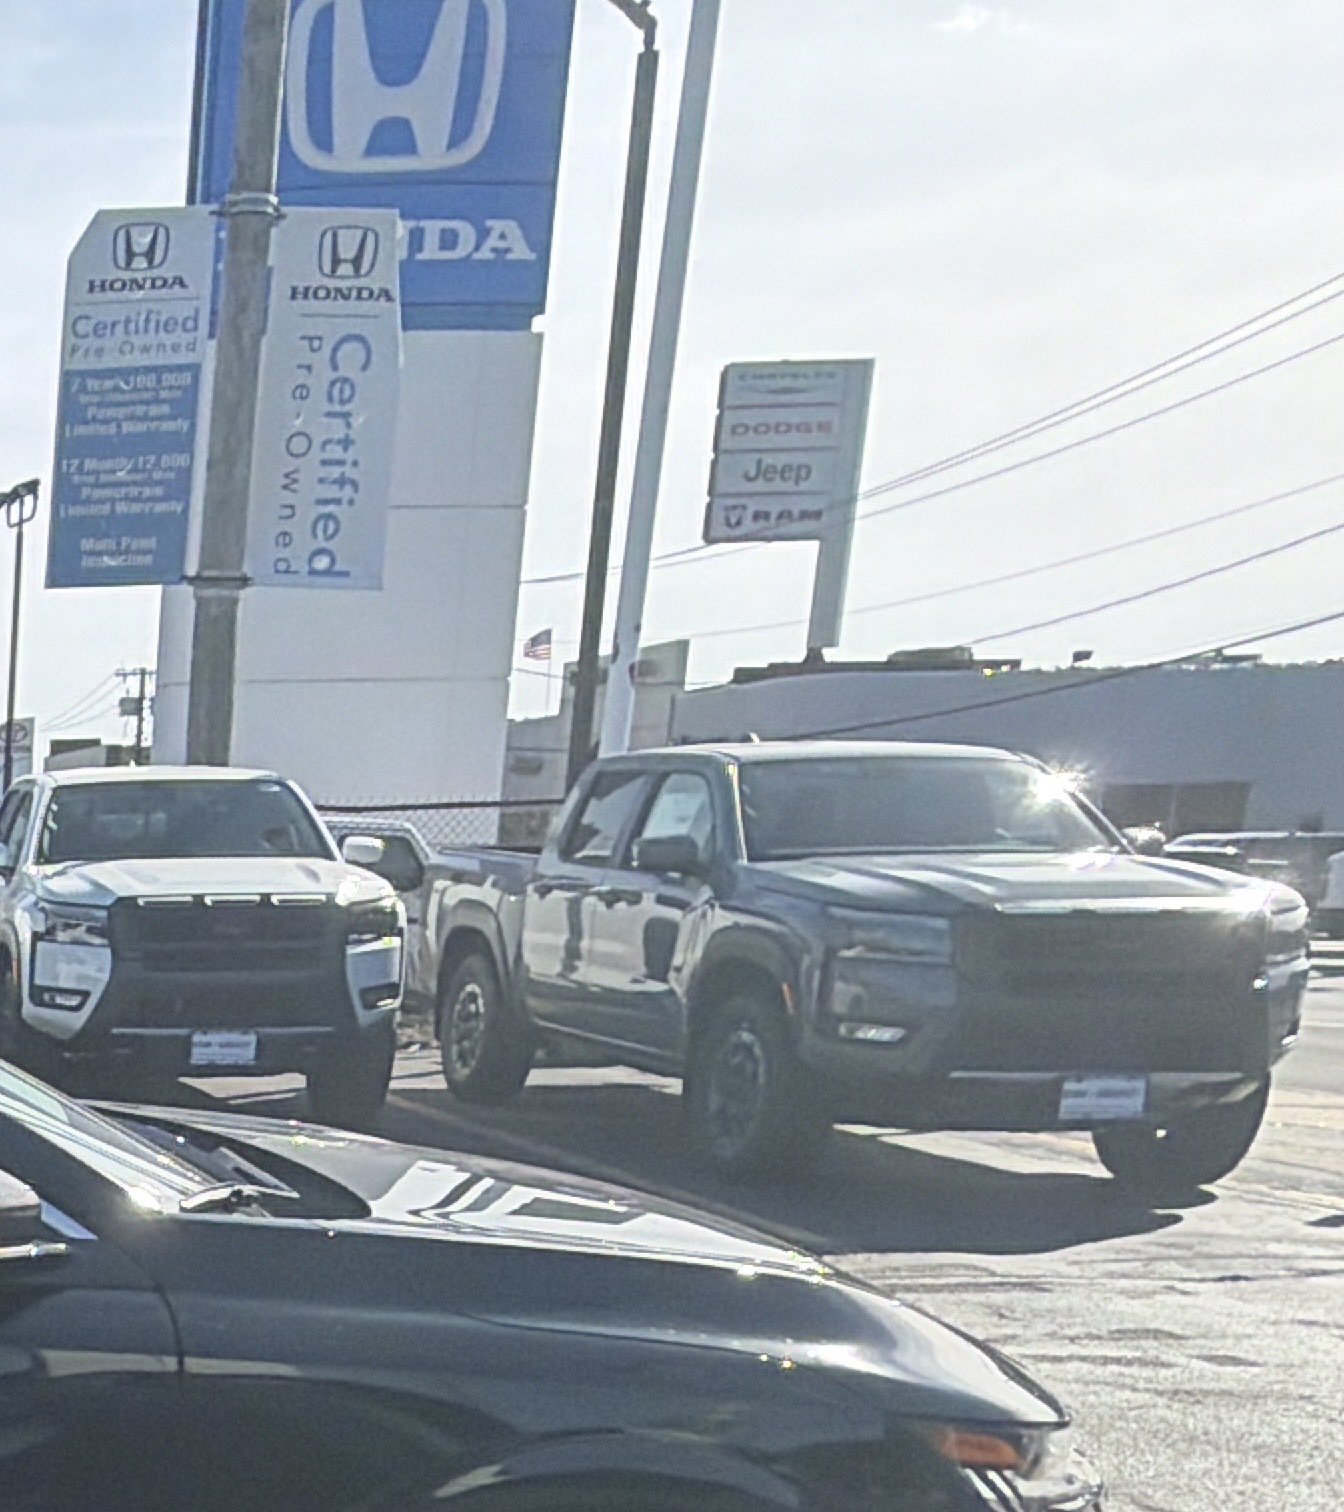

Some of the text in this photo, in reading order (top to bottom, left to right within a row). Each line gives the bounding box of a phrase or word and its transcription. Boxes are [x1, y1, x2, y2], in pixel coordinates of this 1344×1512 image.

[88, 275, 189, 293] HONDA
[290, 285, 395, 303] HONDA
[71, 307, 200, 340] Certified
[731, 421, 834, 436] DODGE
[272, 335, 324, 575] Pre-Owned
[307, 333, 373, 578] Certified
[743, 457, 812, 486] Jeep
[752, 507, 824, 522] RAM
